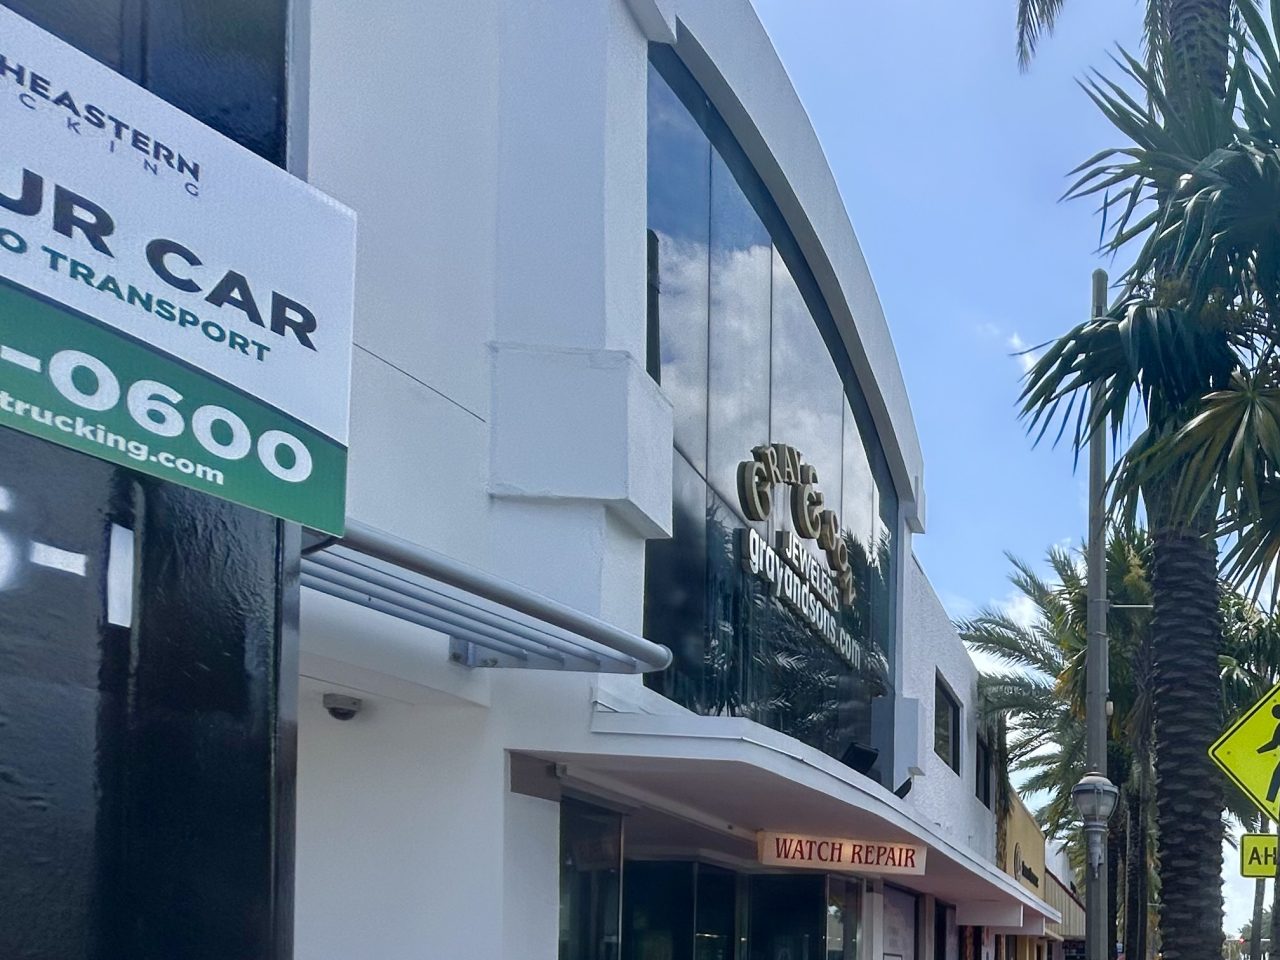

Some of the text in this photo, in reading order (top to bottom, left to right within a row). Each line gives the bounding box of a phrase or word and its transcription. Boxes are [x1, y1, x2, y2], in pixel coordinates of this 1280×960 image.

[0, 54, 199, 182] HEASTERN
[41, 246, 271, 362] TRANSPORT
[146, 238, 318, 352] CAR
[0, 345, 313, 483] -0600
[0, 390, 225, 486] trucking.com
[749, 528, 861, 671] grayandsons.com
[785, 531, 840, 612] JEWELERS
[774, 837, 916, 868] WATCH REPAIR
